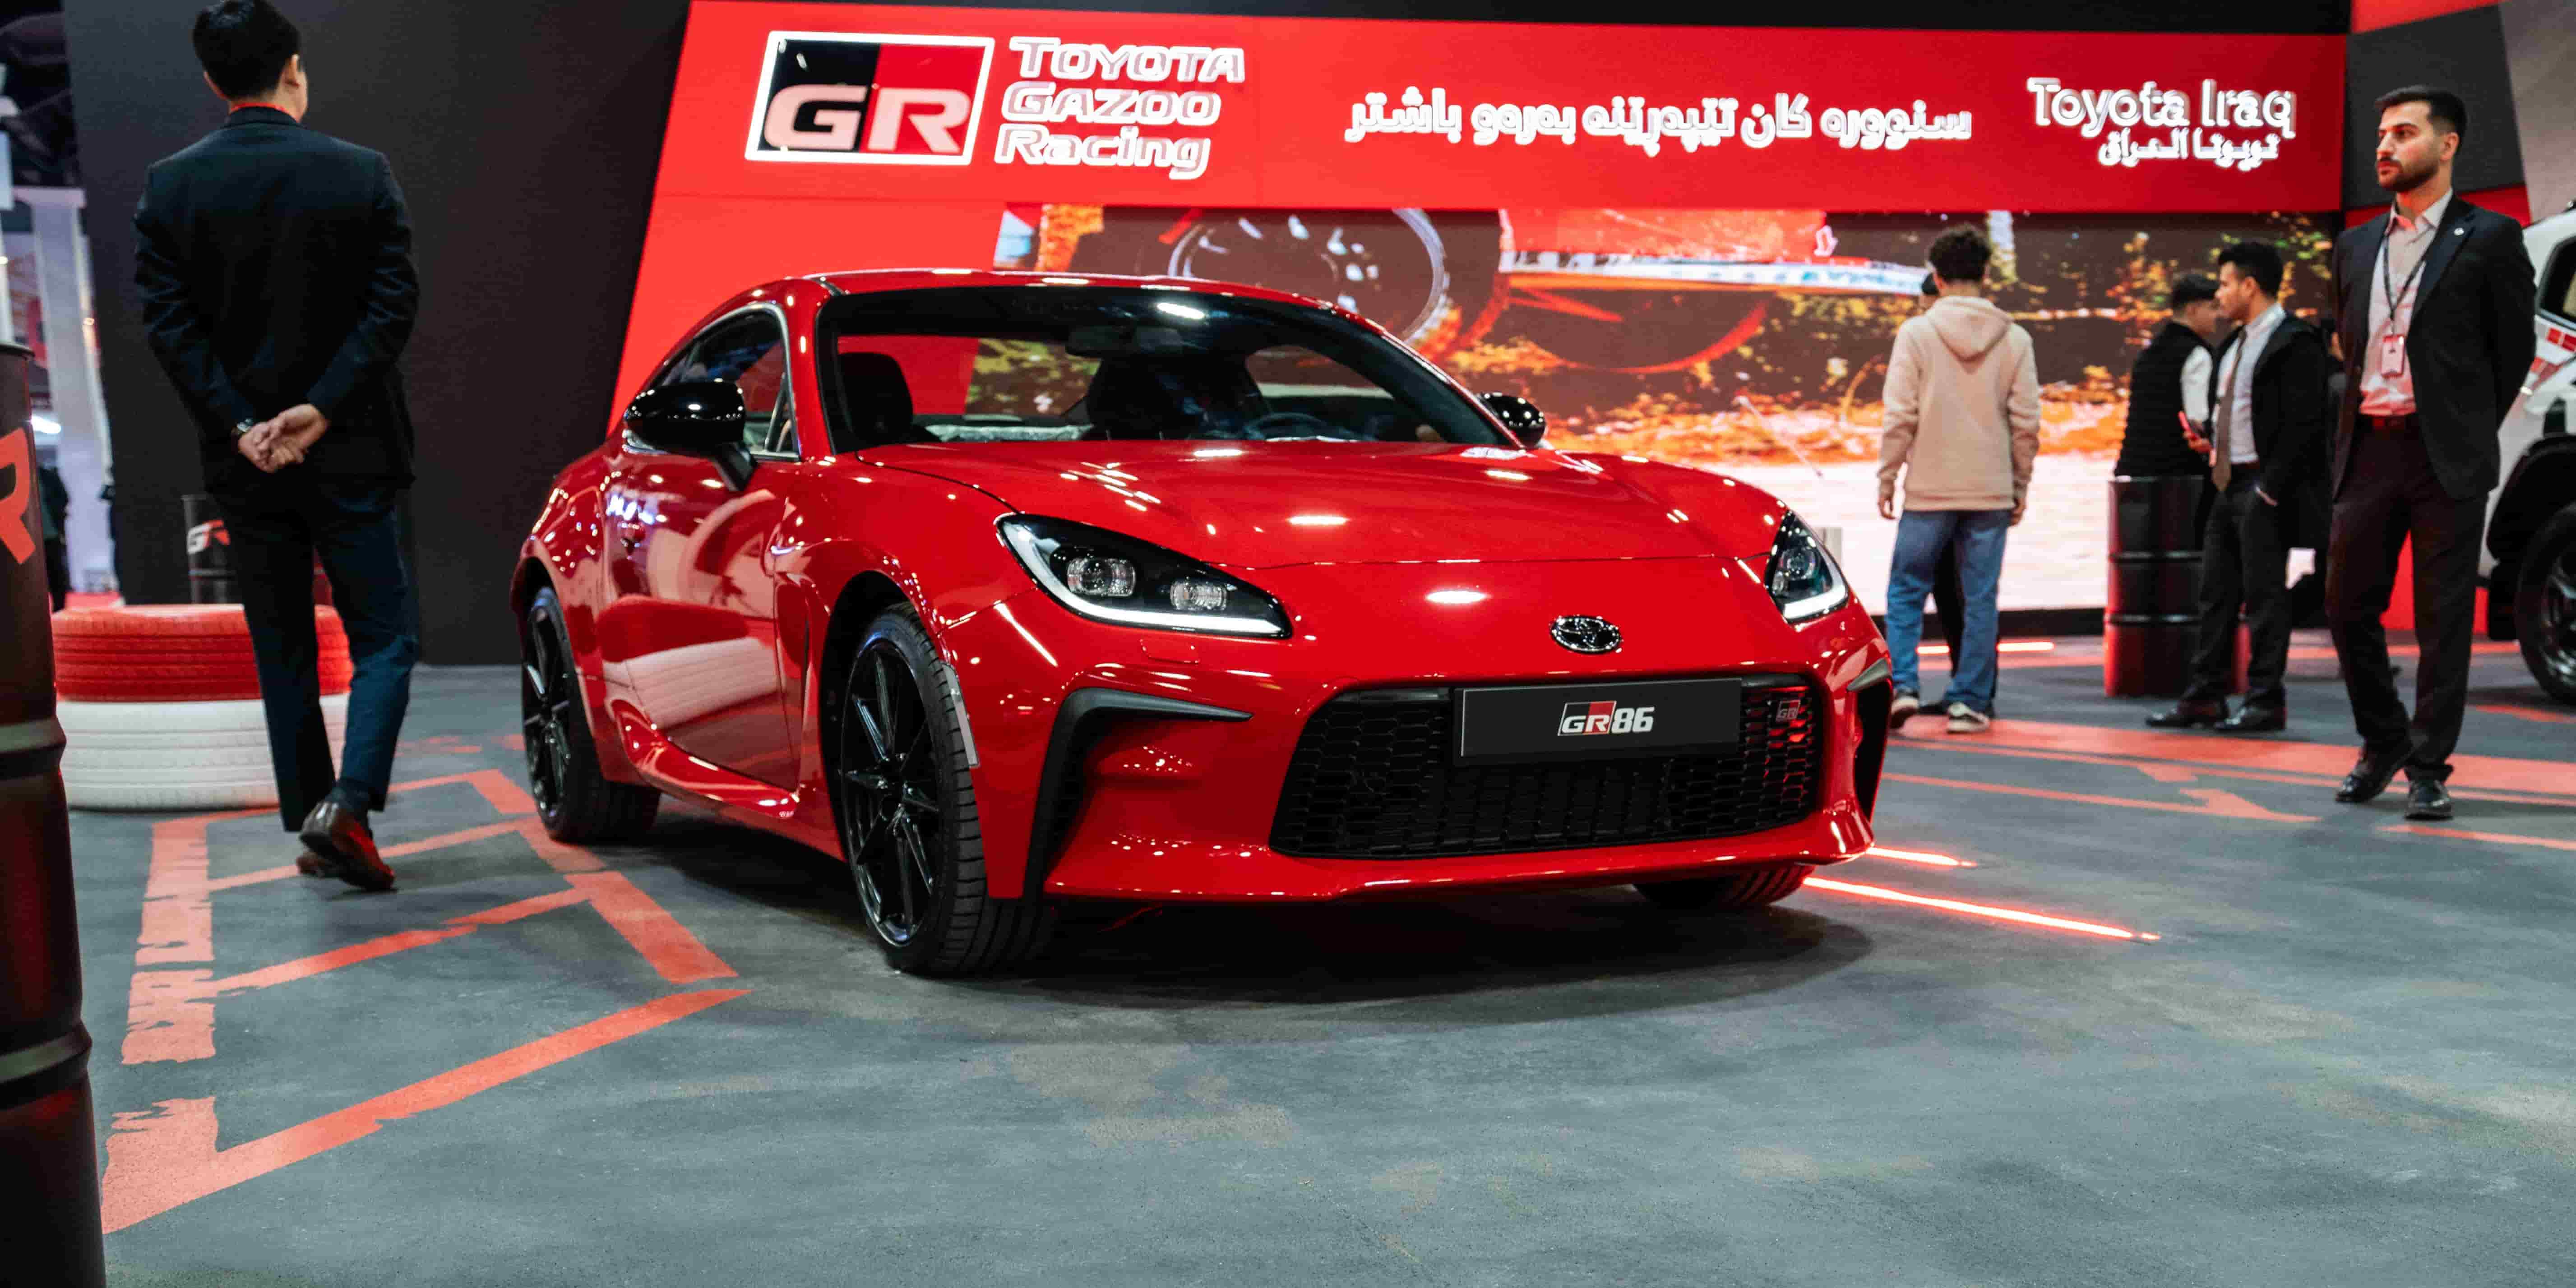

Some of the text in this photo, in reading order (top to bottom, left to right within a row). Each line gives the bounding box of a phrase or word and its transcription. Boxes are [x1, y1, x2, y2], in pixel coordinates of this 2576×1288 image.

[1009, 36, 1246, 83] TOYOTA
[763, 84, 971, 152] GR
[1001, 81, 1221, 126] GAZOO
[1344, 86, 1462, 143] باشتر
[2026, 78, 2296, 139] Toyota Iraq
[994, 123, 1212, 180] Racing
[2098, 127, 2189, 168] العراق
